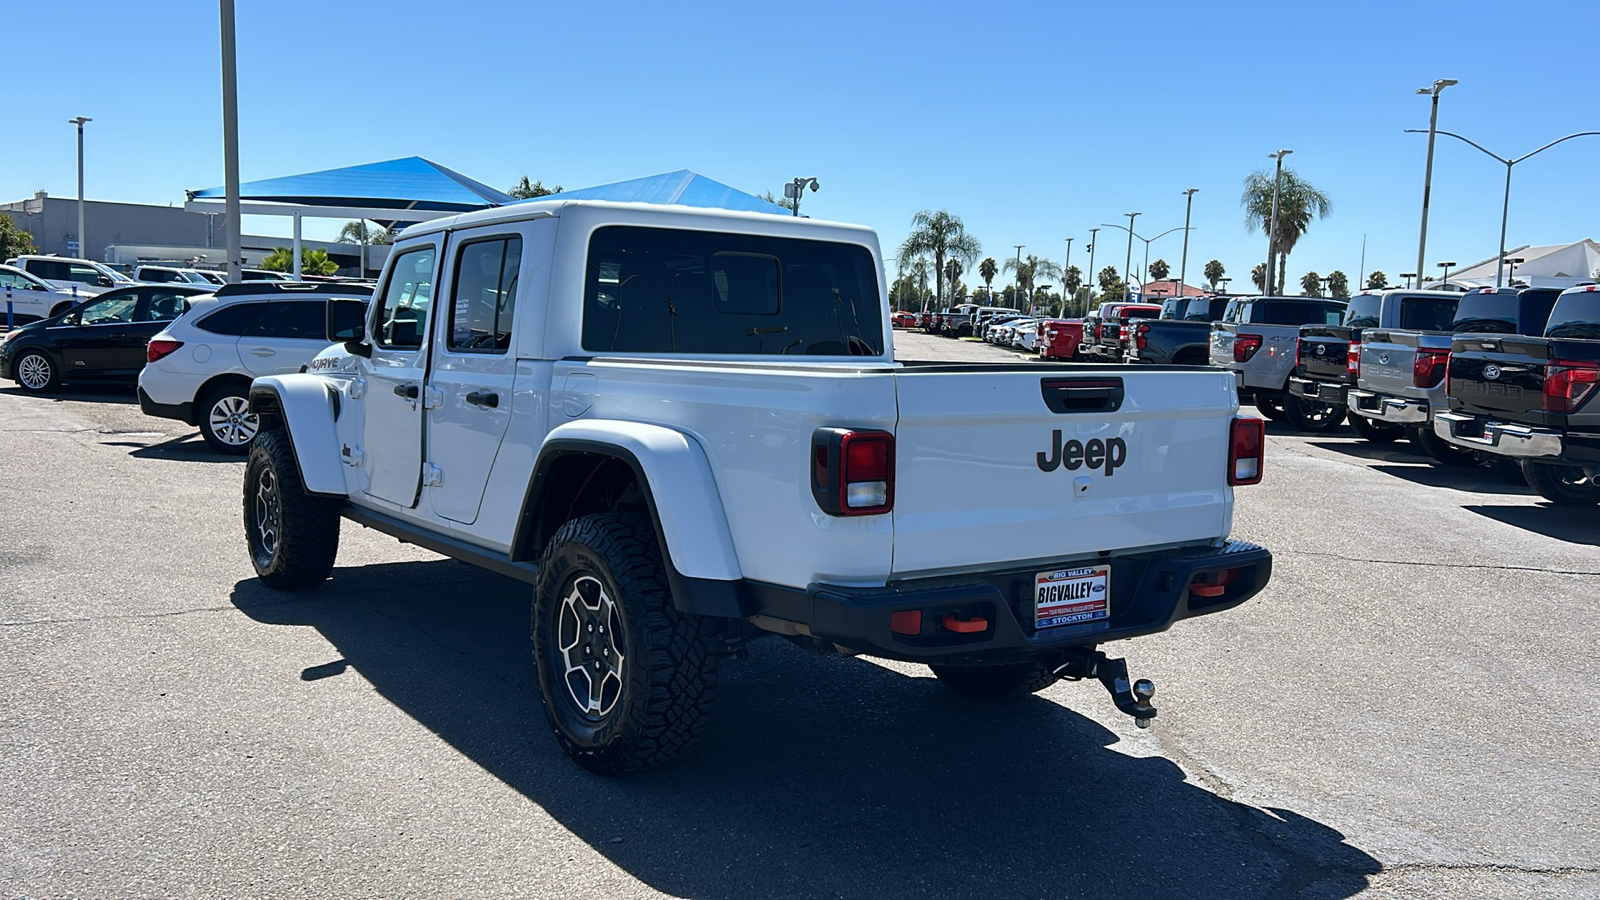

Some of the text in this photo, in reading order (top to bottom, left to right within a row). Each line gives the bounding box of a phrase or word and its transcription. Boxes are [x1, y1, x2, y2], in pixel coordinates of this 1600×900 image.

[1036, 429, 1127, 477] Jeep
[1053, 568, 1093, 579] BIG VALLEY
[1037, 581, 1093, 604] BIGVALLEY
[1052, 613, 1093, 624] STOCKTON
